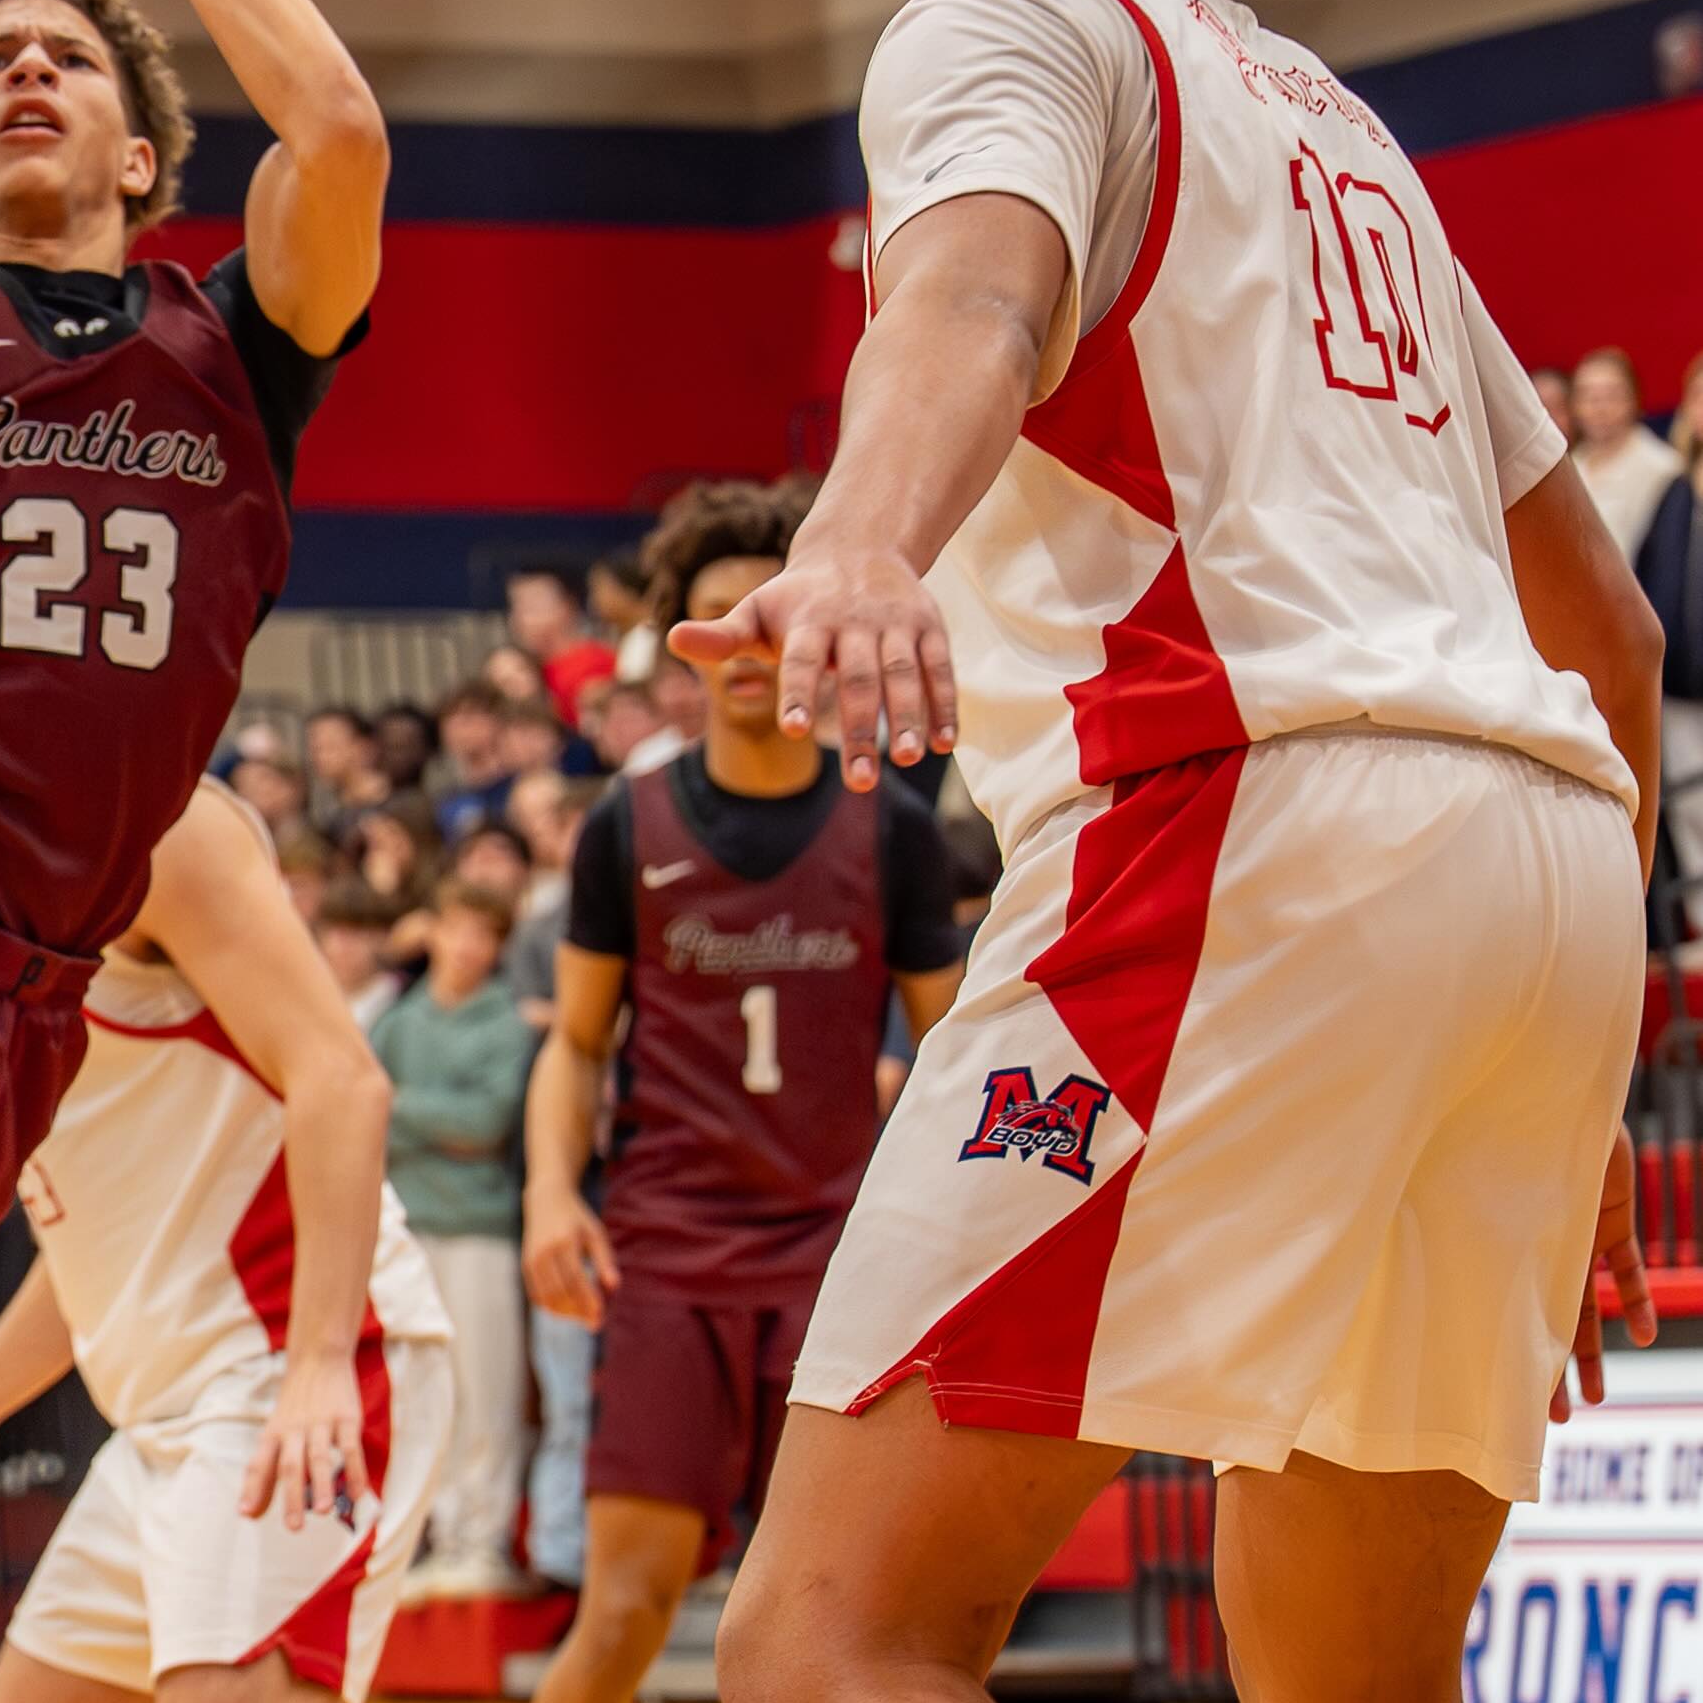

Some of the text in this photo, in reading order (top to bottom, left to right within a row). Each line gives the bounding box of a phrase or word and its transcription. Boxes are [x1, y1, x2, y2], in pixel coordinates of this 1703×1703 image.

[1289, 137, 1452, 437] 10
[0, 496, 180, 671] 23
[663, 913, 860, 975] Panthers
[740, 985, 782, 1094] 1
[983, 1126, 1080, 1157] BOYD
[1551, 1444, 1649, 1503] HOME
